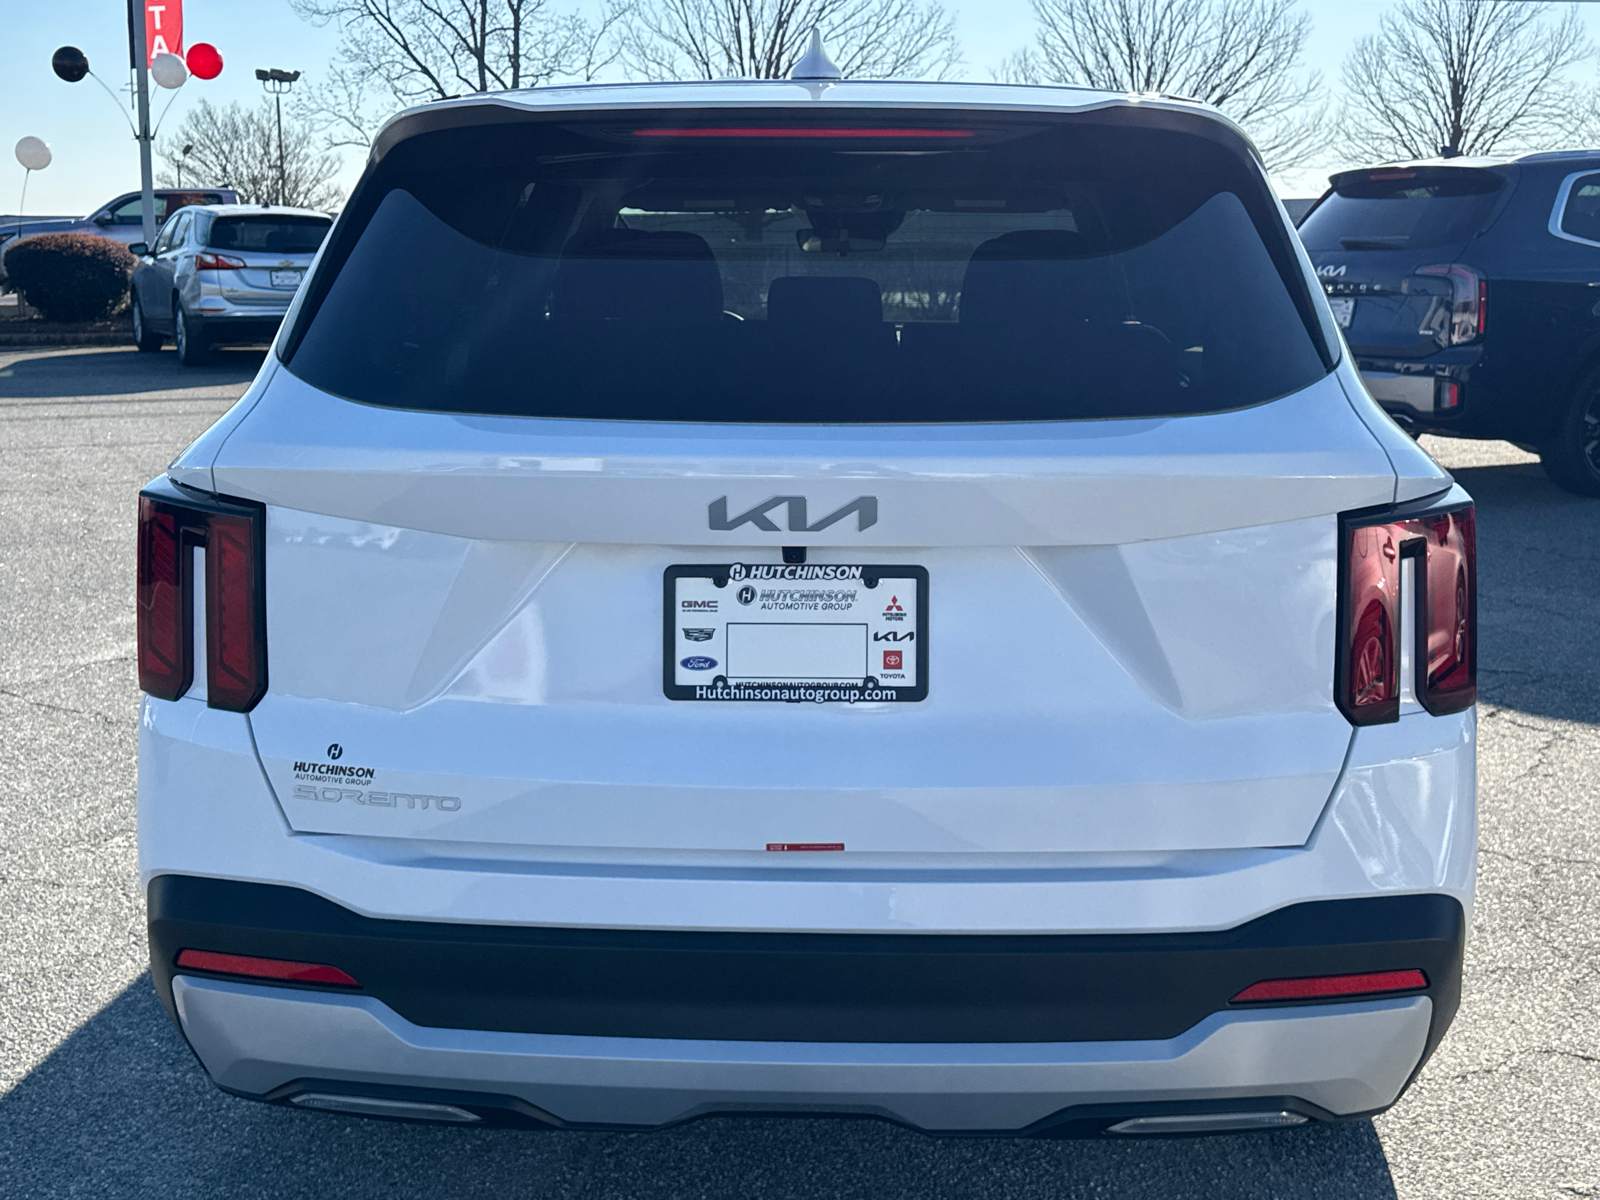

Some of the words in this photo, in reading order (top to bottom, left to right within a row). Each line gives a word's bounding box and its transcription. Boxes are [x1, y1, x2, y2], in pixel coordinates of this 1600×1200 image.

[148, 0, 170, 59] TA
[708, 495, 878, 532] KIA
[750, 566, 862, 580] HUTCHINSON
[759, 589, 857, 602] HUTCHINSON
[681, 600, 719, 608] GMC
[761, 603, 819, 611] AUTOMOTIVE
[821, 603, 853, 611] GROUP
[873, 631, 915, 642] KIA
[687, 658, 711, 669] Ford
[695, 686, 897, 702] Hutchinsonautogroup.com
[293, 761, 375, 779] HUTCHINSON
[295, 774, 343, 784] AUTOMOTIVE
[345, 777, 372, 786] GROUP
[293, 784, 462, 812] SORENTO
